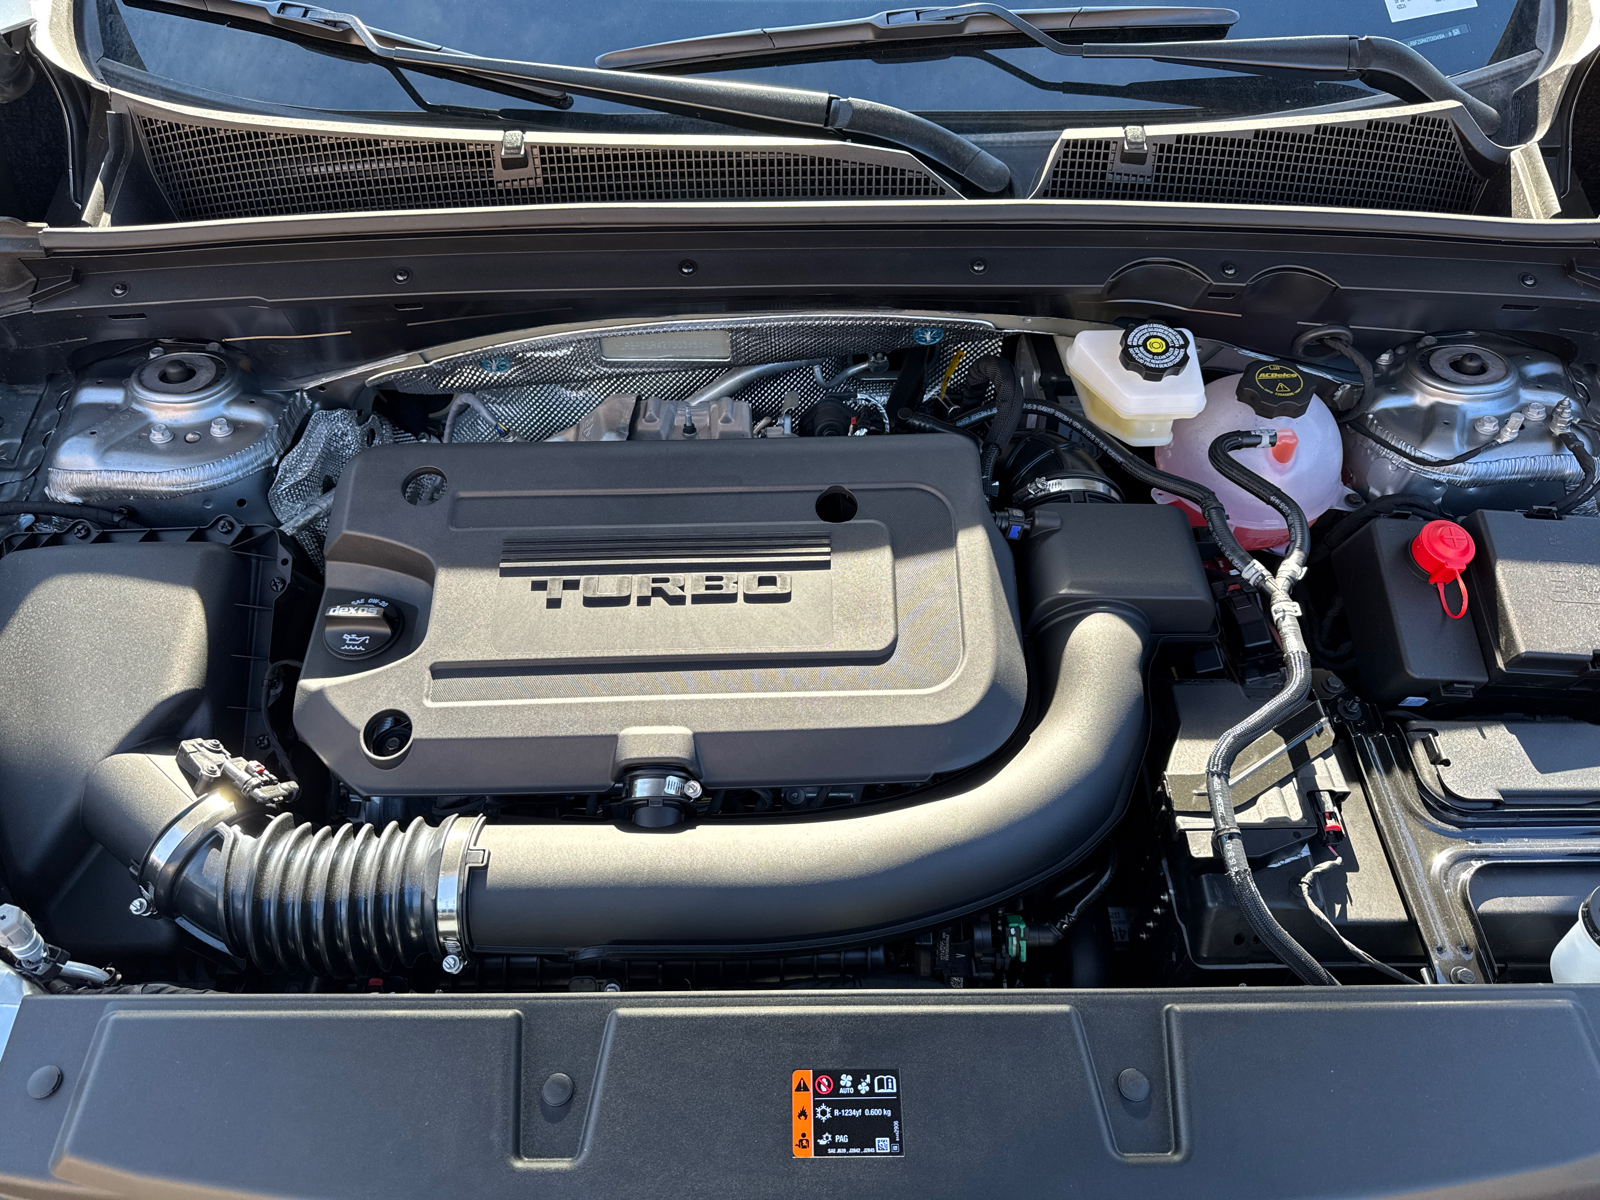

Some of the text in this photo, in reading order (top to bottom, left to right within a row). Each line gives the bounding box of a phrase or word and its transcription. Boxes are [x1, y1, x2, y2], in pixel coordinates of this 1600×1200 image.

[530, 573, 792, 609] TURBO
[329, 605, 378, 615] dexos
[834, 1109, 862, 1117] R-1234yf
[883, 1109, 892, 1117] kg
[835, 1135, 849, 1143] PAG
